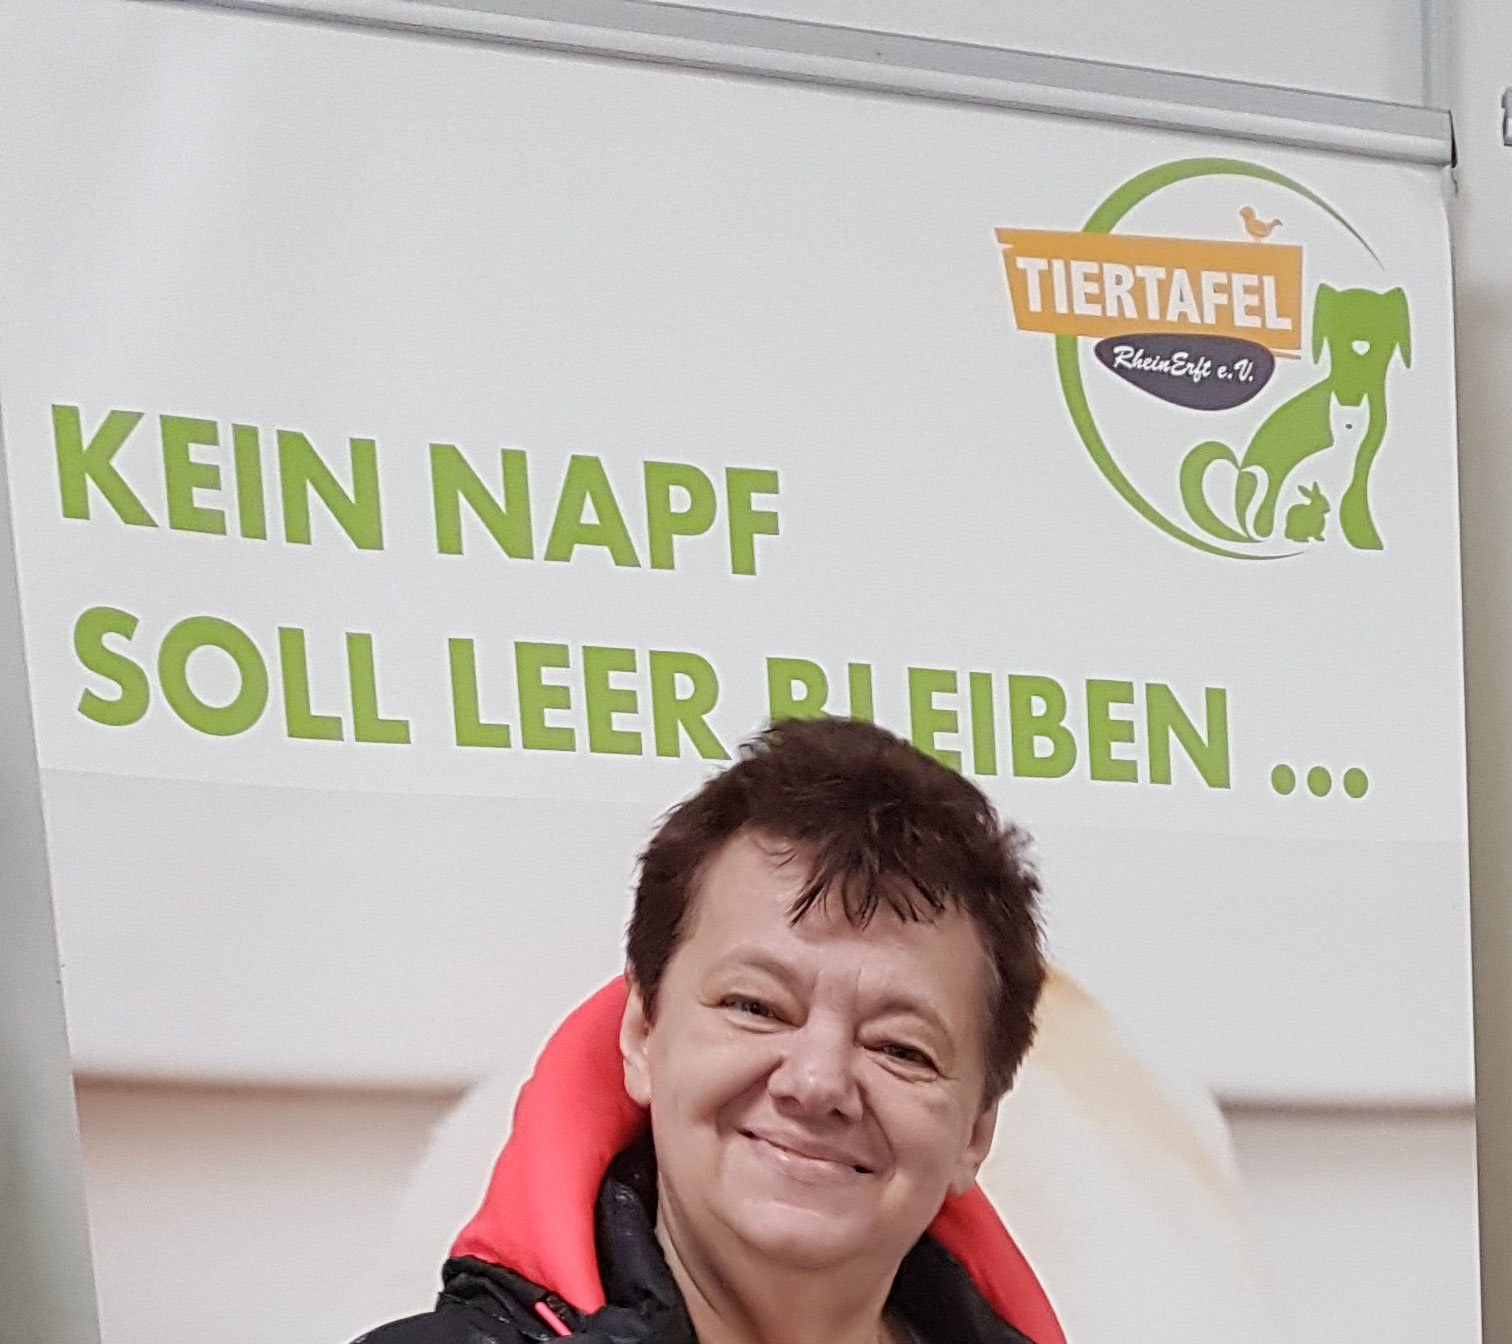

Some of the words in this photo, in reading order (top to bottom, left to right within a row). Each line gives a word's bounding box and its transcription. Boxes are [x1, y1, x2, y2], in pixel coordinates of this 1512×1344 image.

[1016, 257, 1292, 330] TIERTAFEL
[1113, 346, 1211, 383] RheinErft
[1217, 361, 1254, 382] e.V.
[50, 404, 385, 551] KEIN
[429, 442, 781, 577] NAPF
[72, 606, 411, 745] SOLL
[447, 636, 732, 761] LEER
